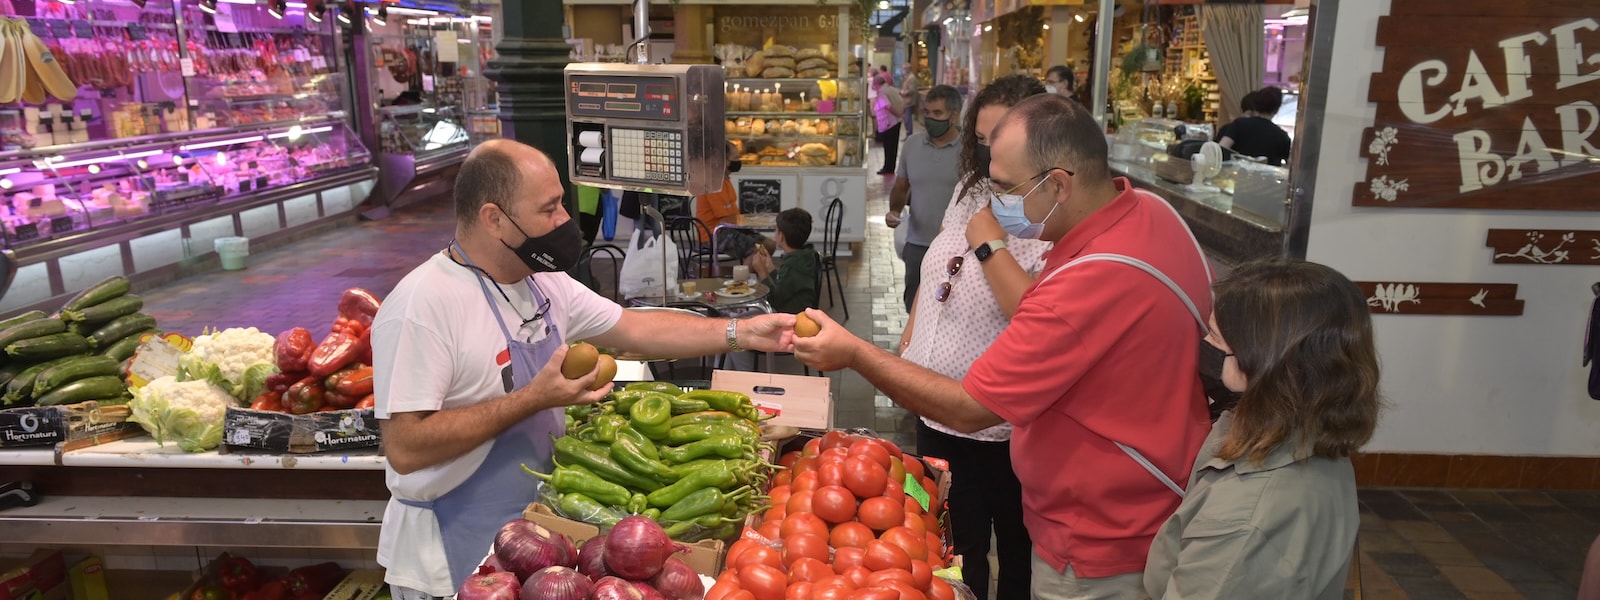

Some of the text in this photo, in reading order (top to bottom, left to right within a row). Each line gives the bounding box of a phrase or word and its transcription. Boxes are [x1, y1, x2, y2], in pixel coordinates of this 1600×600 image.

[721, 15, 809, 32] gomezpan
[1397, 17, 1600, 124] CAFE
[1452, 100, 1600, 194] BAR
